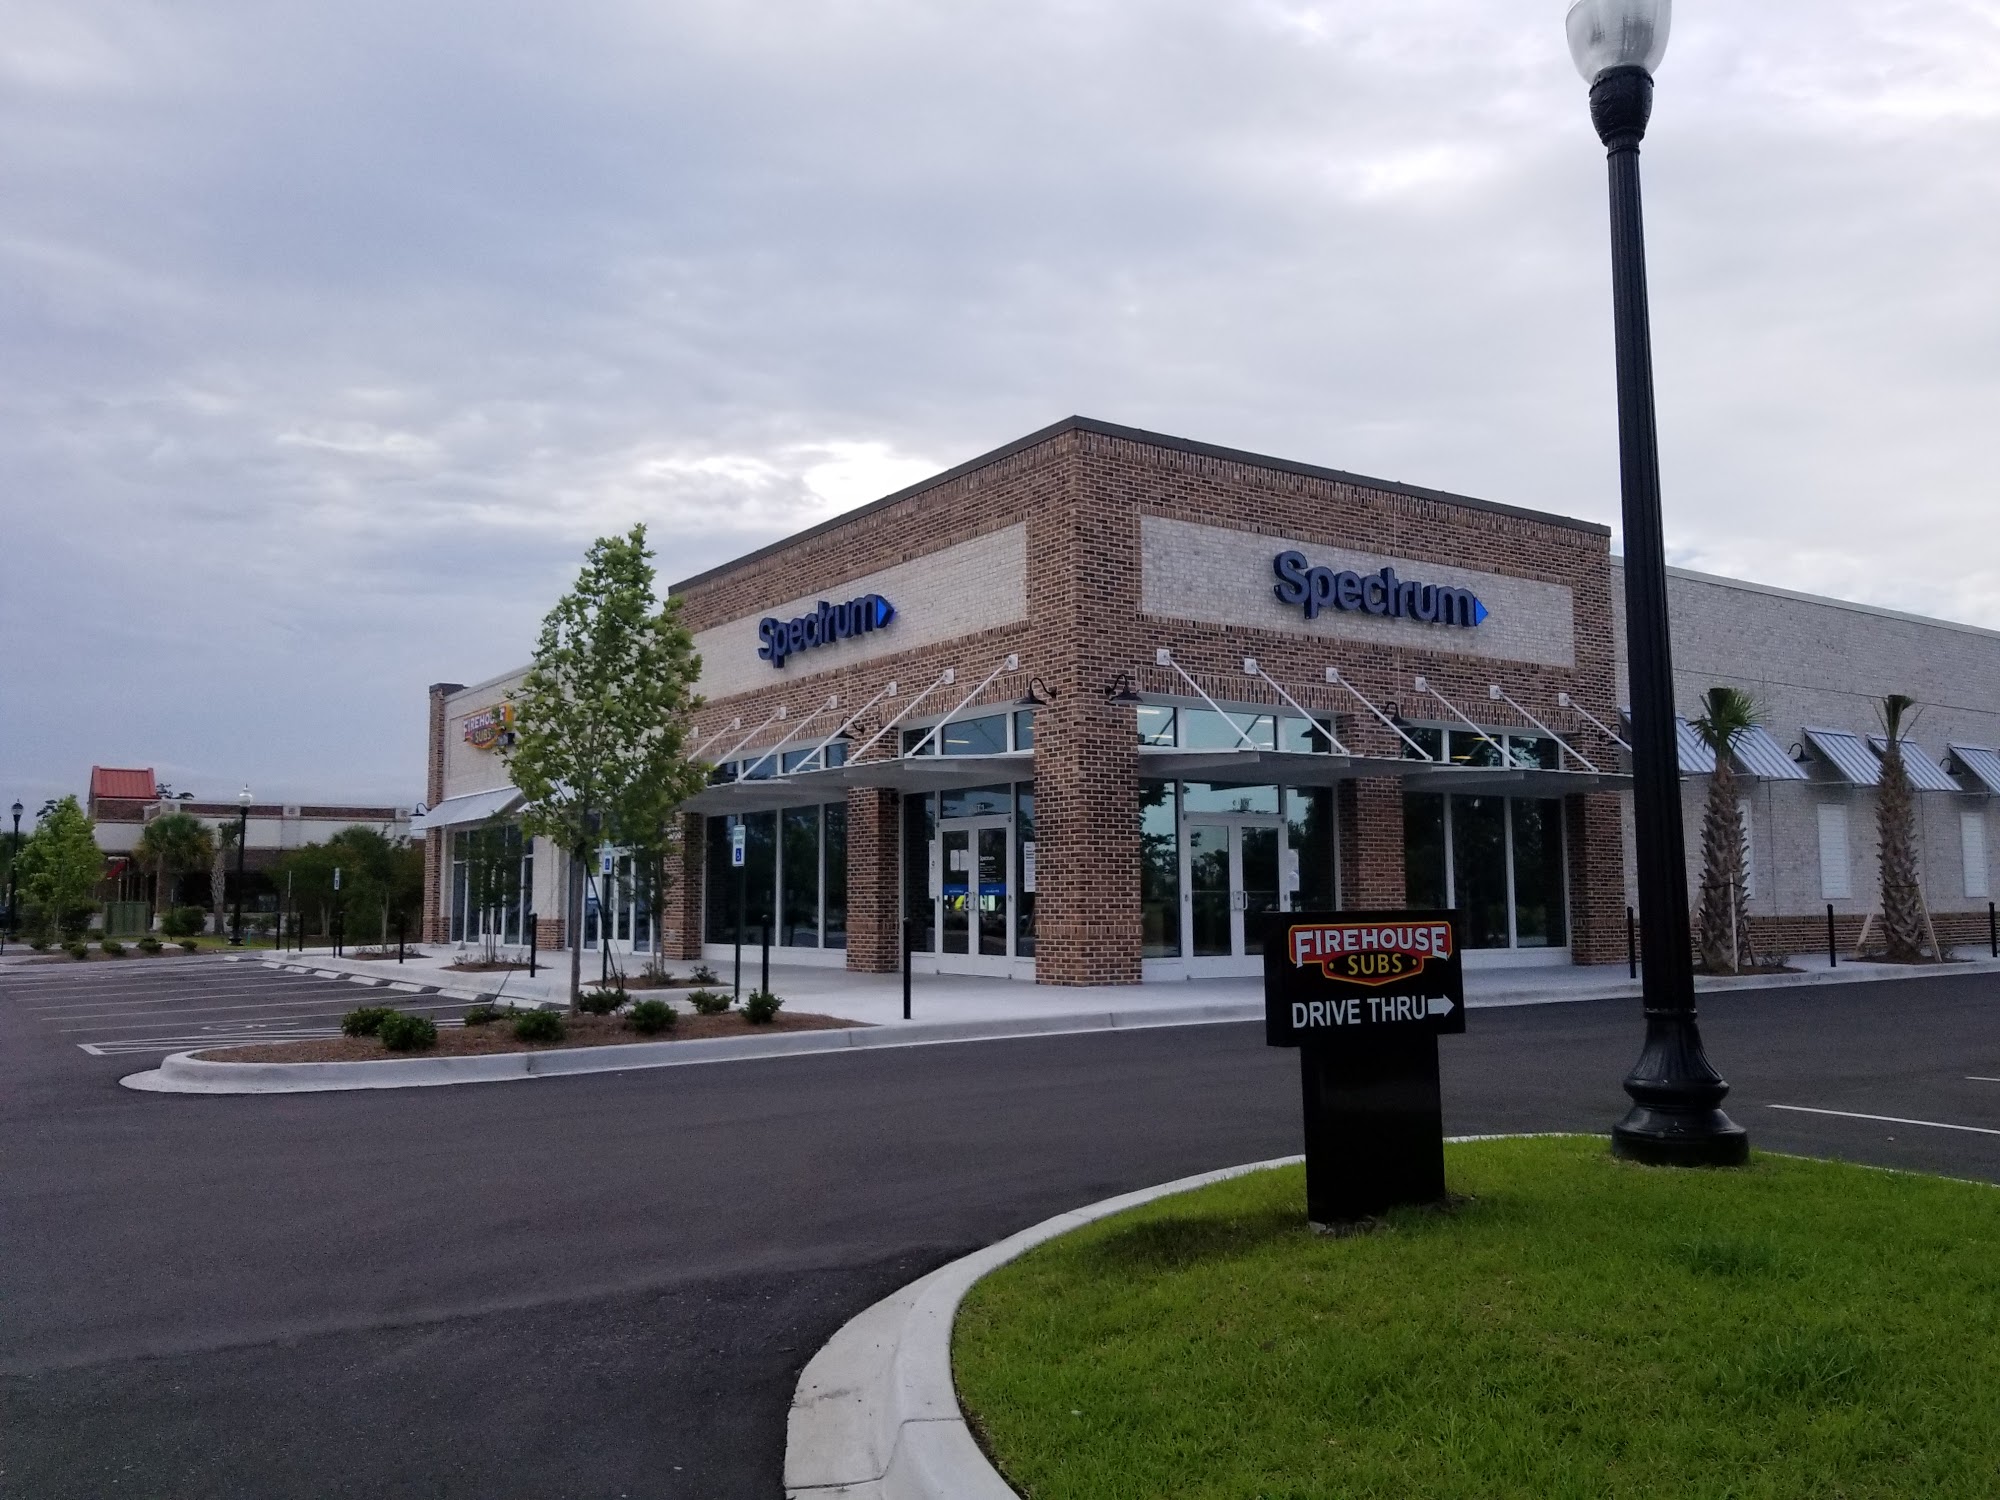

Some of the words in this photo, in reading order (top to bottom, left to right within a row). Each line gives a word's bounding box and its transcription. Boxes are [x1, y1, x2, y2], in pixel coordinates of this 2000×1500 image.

[1273, 551, 1477, 627] Spectrum
[758, 594, 879, 668] Spectrum
[1294, 926, 1449, 968] FIREHOUSE
[1347, 953, 1403, 975] SUBS
[1291, 999, 1362, 1028] DRIVE
[1367, 994, 1426, 1022] THRU
